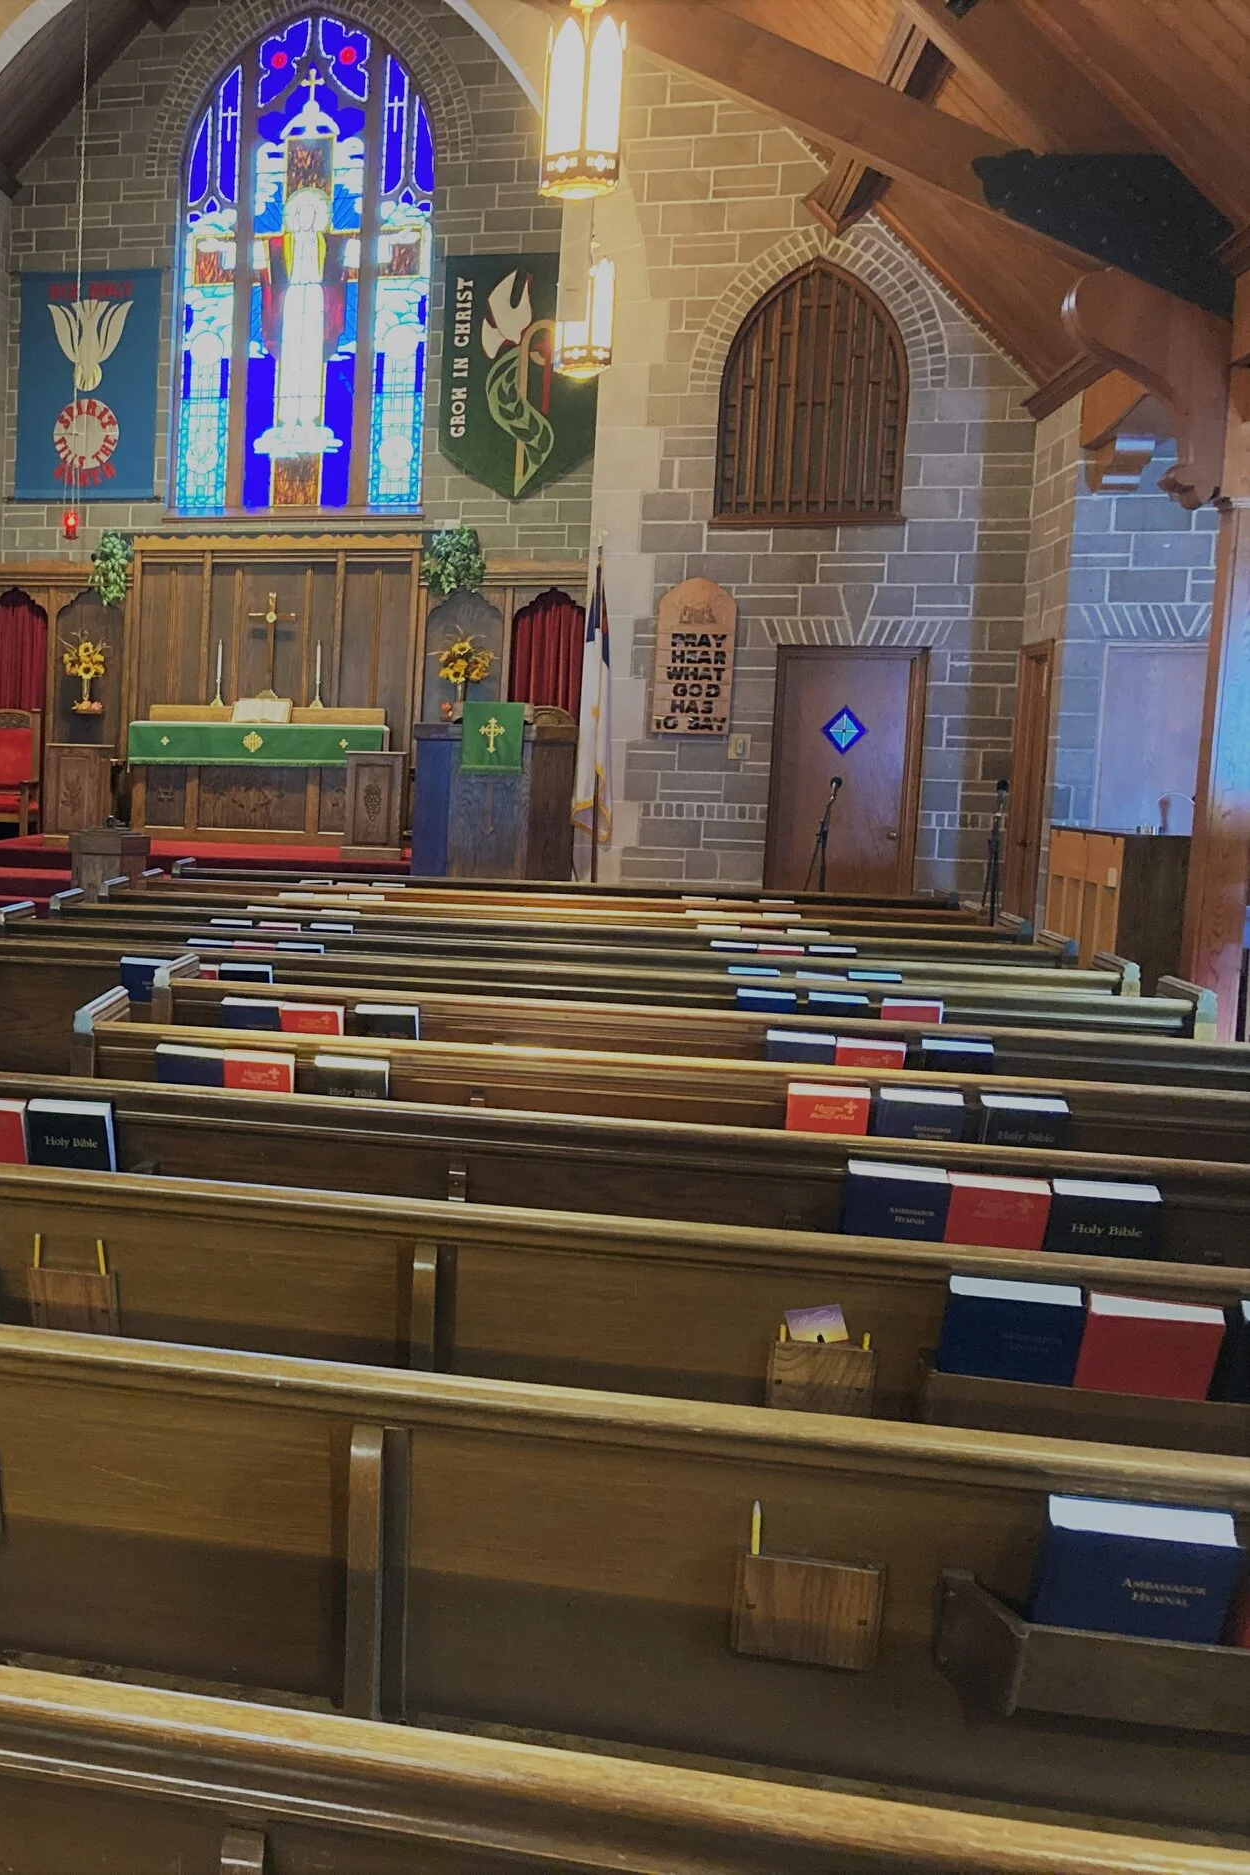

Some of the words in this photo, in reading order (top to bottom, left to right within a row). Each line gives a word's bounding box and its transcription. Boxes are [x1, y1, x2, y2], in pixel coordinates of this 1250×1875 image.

[454, 277, 474, 348] CHRIST
[453, 357, 469, 378] IN
[58, 399, 117, 430] SPIRIT
[450, 386, 467, 438] GROW
[92, 435, 118, 464] THE
[671, 633, 727, 648] PRAY
[671, 650, 727, 665] HEAR
[666, 666, 726, 681] WHAT
[672, 683, 721, 698] GOD
[670, 699, 713, 714] HAS
[654, 715, 678, 730] TO
[687, 716, 727, 731] SAY
[44, 1136, 70, 1147] Holy
[72, 1137, 98, 1149] Bible
[1071, 1222, 1105, 1238] Holy
[1107, 1225, 1143, 1239] Bible
